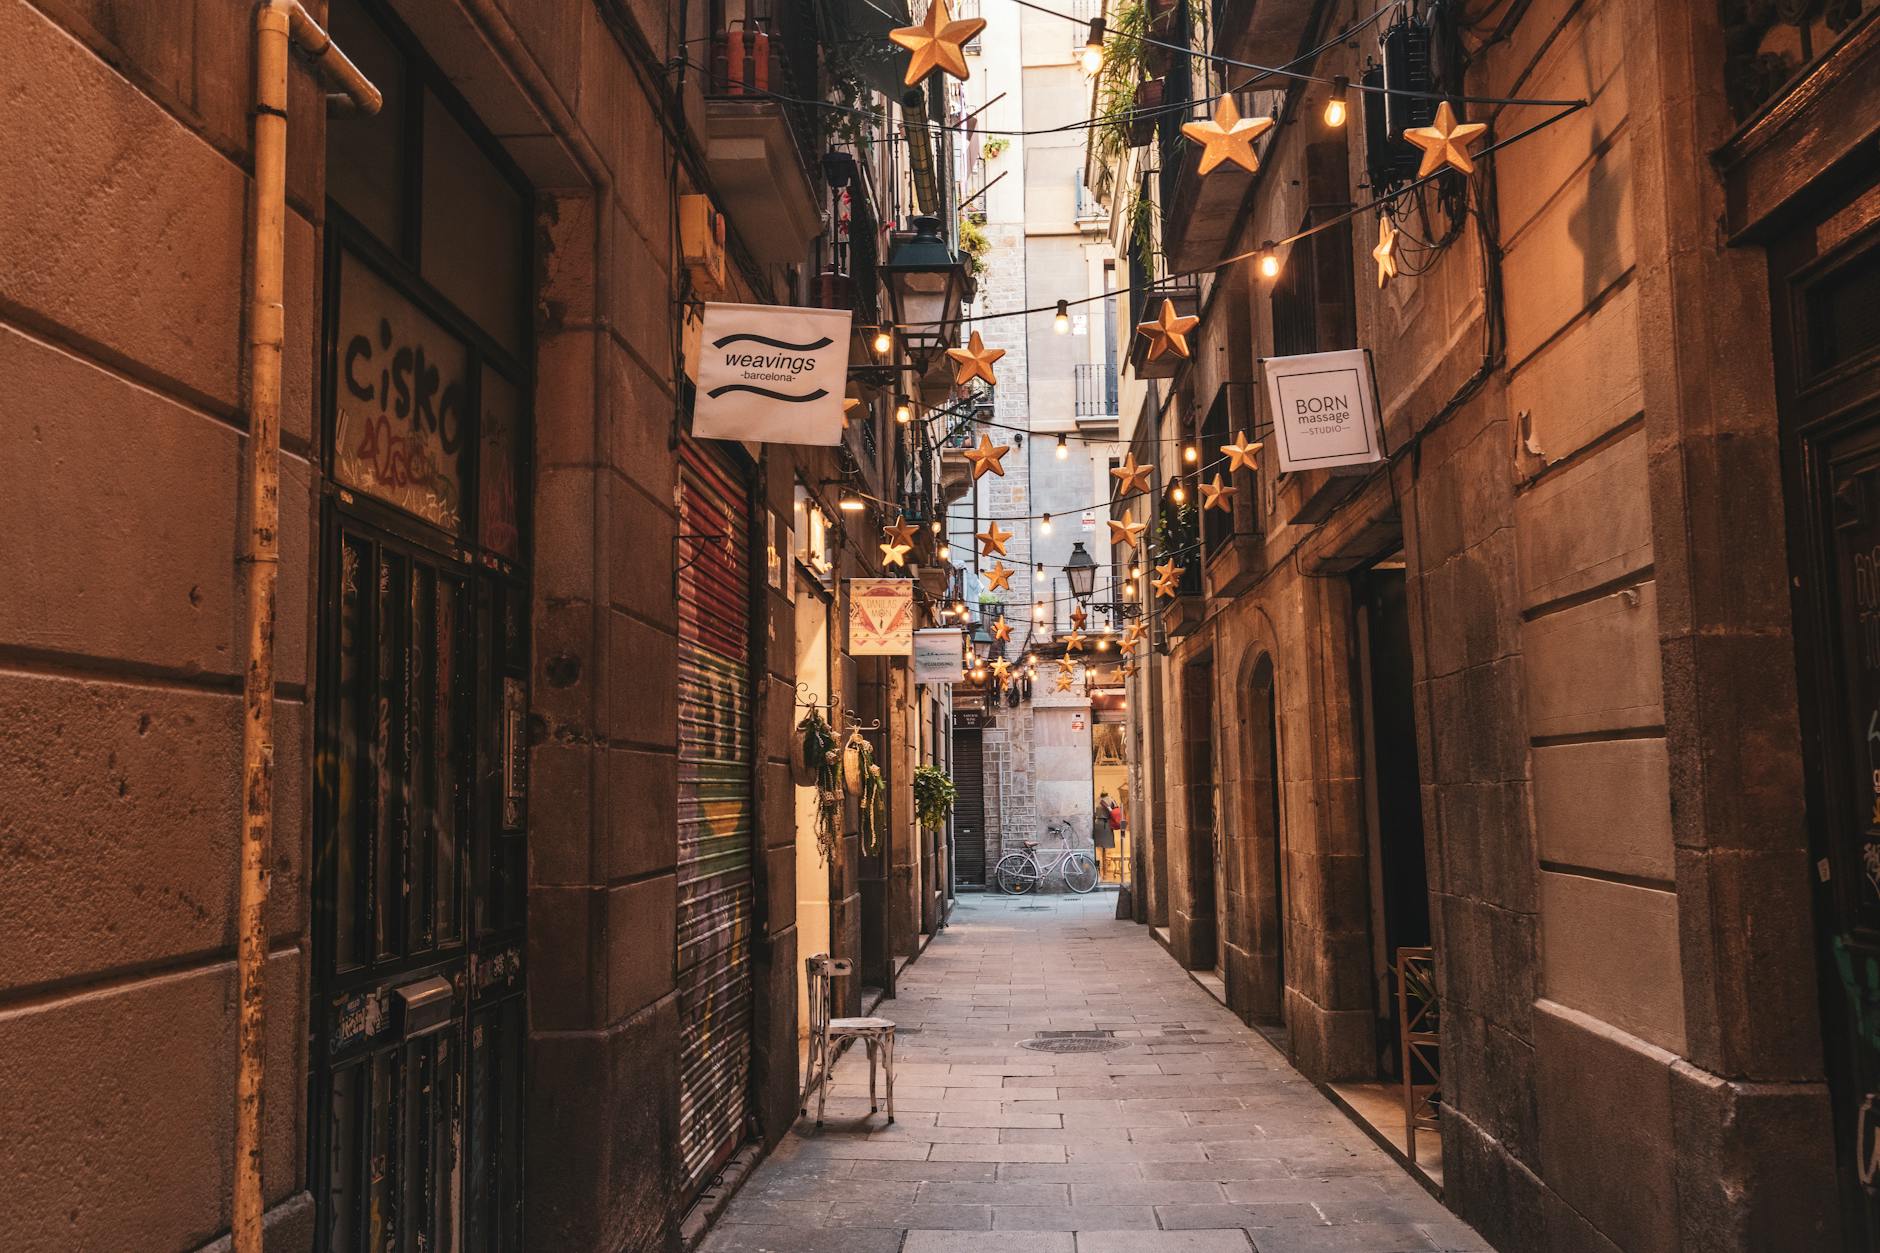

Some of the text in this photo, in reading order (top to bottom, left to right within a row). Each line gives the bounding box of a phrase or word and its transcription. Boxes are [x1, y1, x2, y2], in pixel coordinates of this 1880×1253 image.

[725, 353, 816, 375] weavings
[1295, 394, 1349, 415] BORN
[1297, 411, 1350, 424] massage
